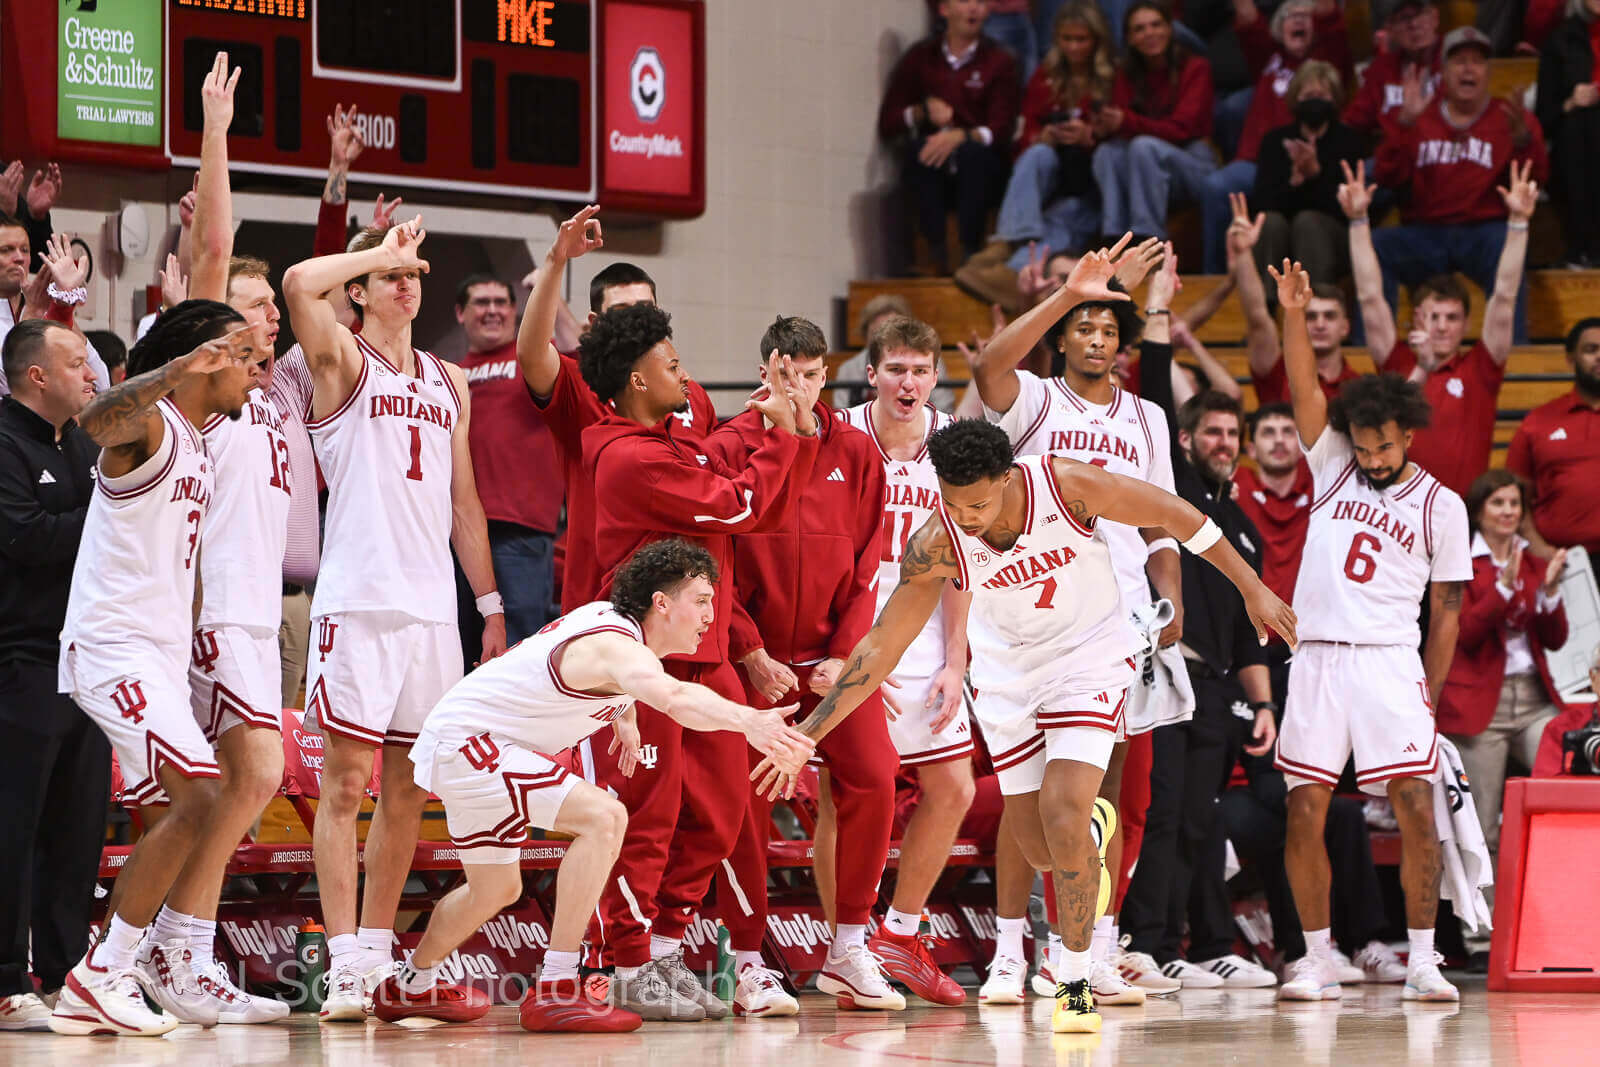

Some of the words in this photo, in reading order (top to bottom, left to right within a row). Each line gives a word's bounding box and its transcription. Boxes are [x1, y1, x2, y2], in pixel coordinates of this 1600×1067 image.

[64, 17, 134, 54] Greene
[497, 0, 555, 47] MKE
[64, 52, 154, 91] &Schultz
[76, 104, 105, 122] TRIAL
[108, 106, 154, 126] LAWYERS
[340, 111, 396, 150] RIOD
[610, 129, 683, 159] CountryMark
[370, 394, 452, 434] INDIANA
[267, 430, 291, 496] 12
[406, 425, 423, 481] 1
[1048, 430, 1139, 468] INDIANA
[884, 484, 939, 511] DIANA
[185, 509, 200, 570] 3
[1332, 500, 1415, 554] INDIANA
[973, 551, 988, 563] 76
[981, 546, 1077, 590] INDIANA
[1344, 531, 1382, 584] 6
[1019, 576, 1057, 609] 7
[292, 729, 324, 749] Germ
